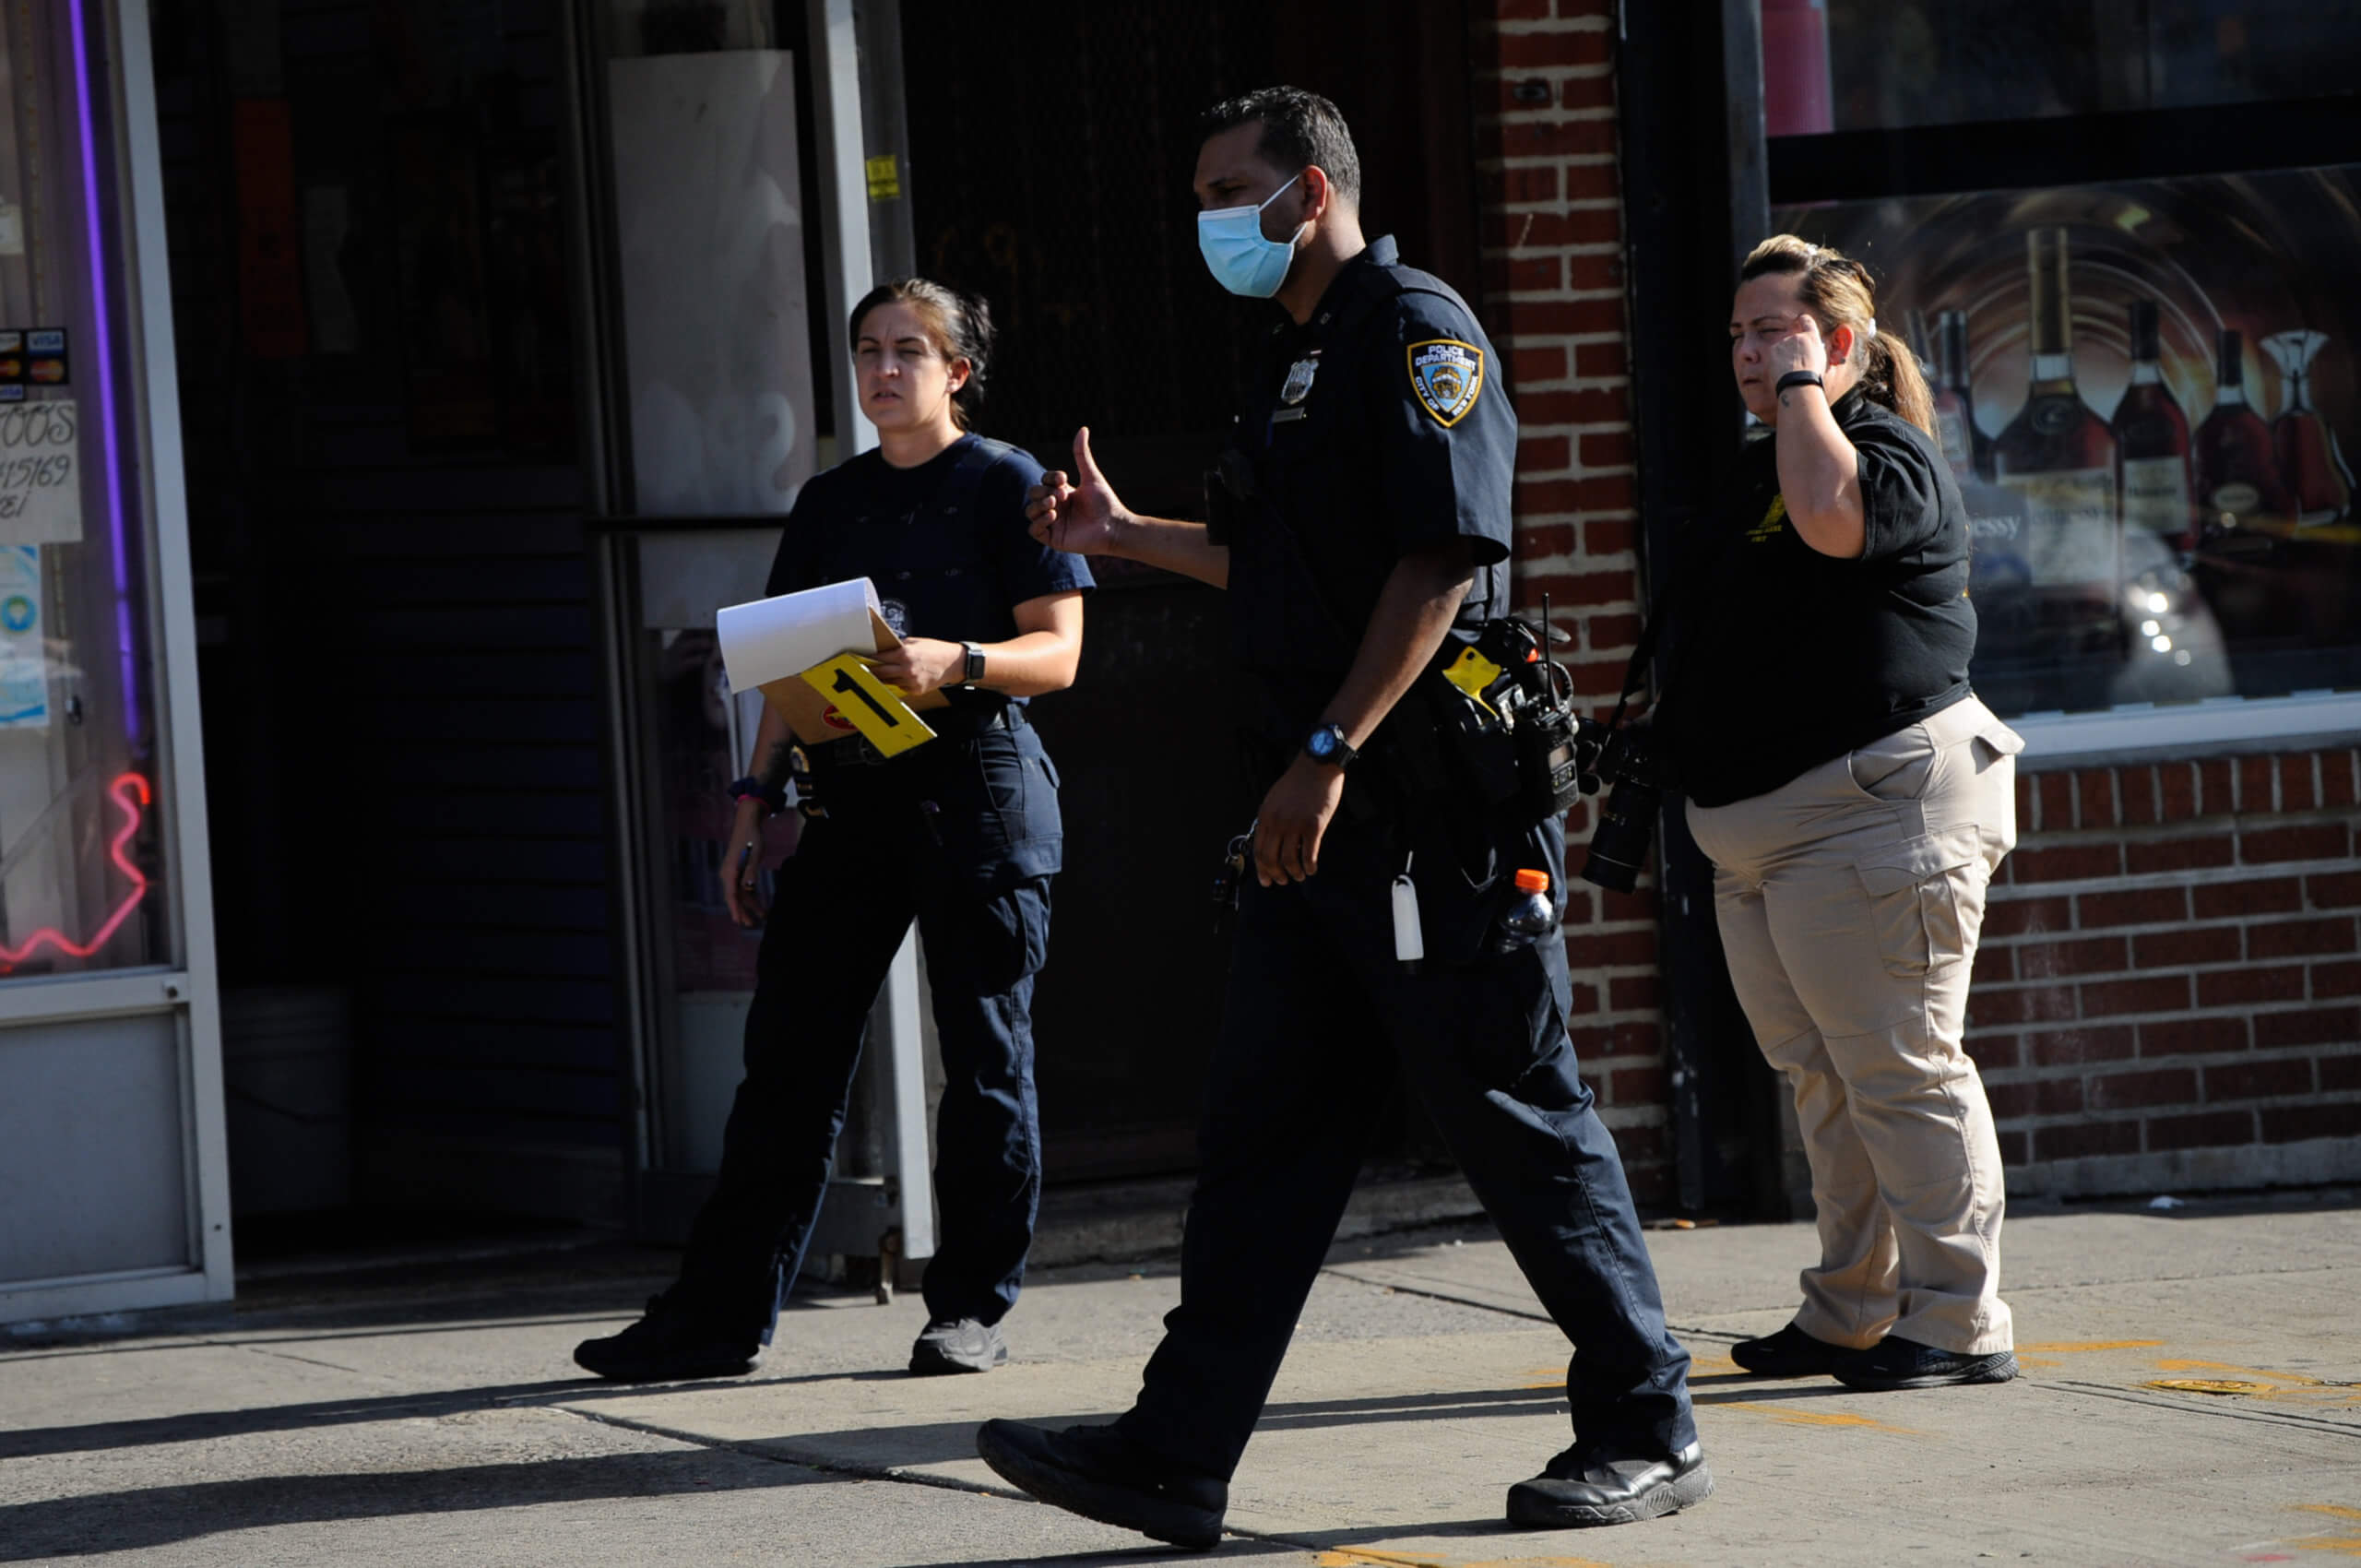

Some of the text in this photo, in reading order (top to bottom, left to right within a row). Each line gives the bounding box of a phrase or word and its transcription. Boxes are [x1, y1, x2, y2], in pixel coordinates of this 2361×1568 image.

[31, 334, 62, 347] VISA
[1428, 345, 1465, 357] POLICE
[1415, 354, 1476, 371] DEPARTMENT
[1415, 375, 1440, 411] CITY OF
[1452, 375, 1478, 416] NEW YORK
[832, 668, 899, 728] 1
